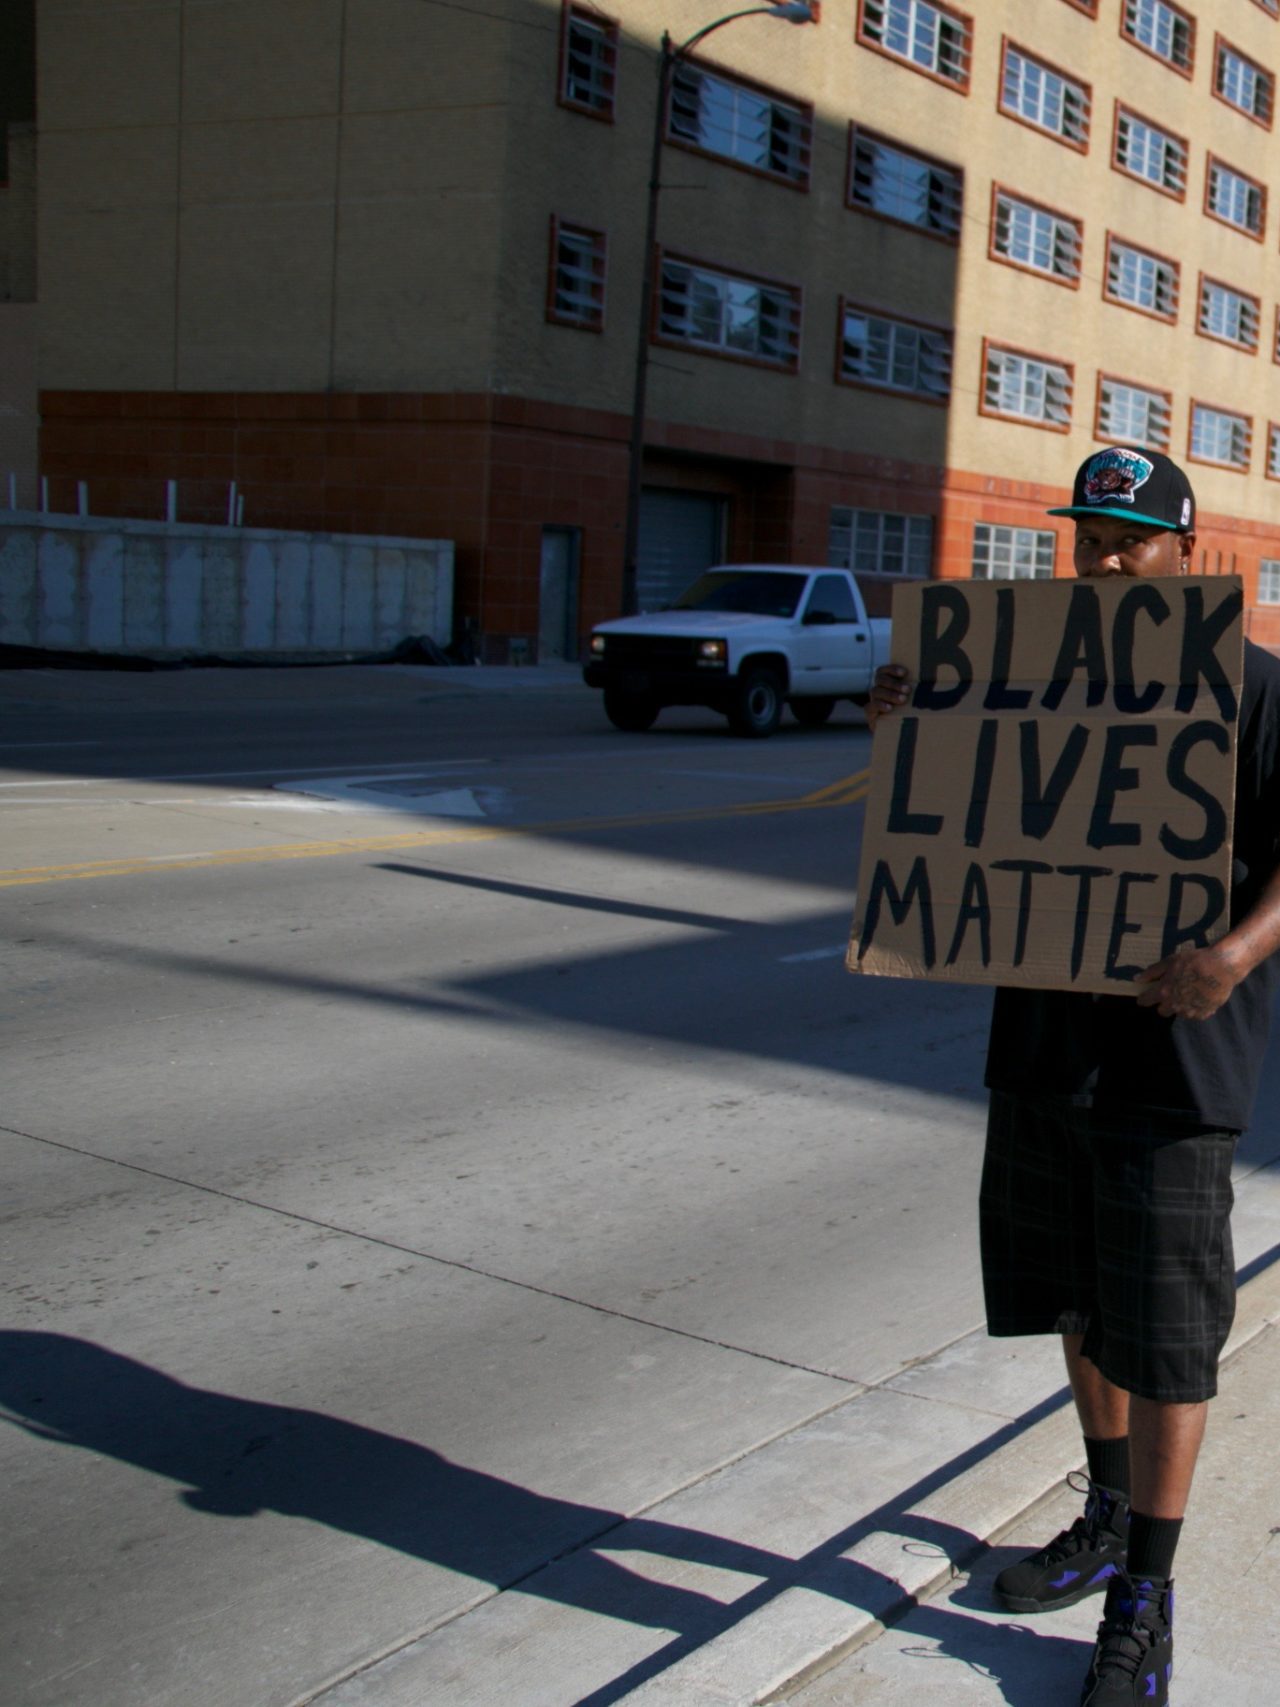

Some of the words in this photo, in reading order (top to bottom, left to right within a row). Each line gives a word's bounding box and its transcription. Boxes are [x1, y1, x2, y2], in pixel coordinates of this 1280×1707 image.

[911, 584, 1243, 723] BLACK
[887, 717, 1231, 861] LIVES
[857, 855, 1226, 982] MATTER
